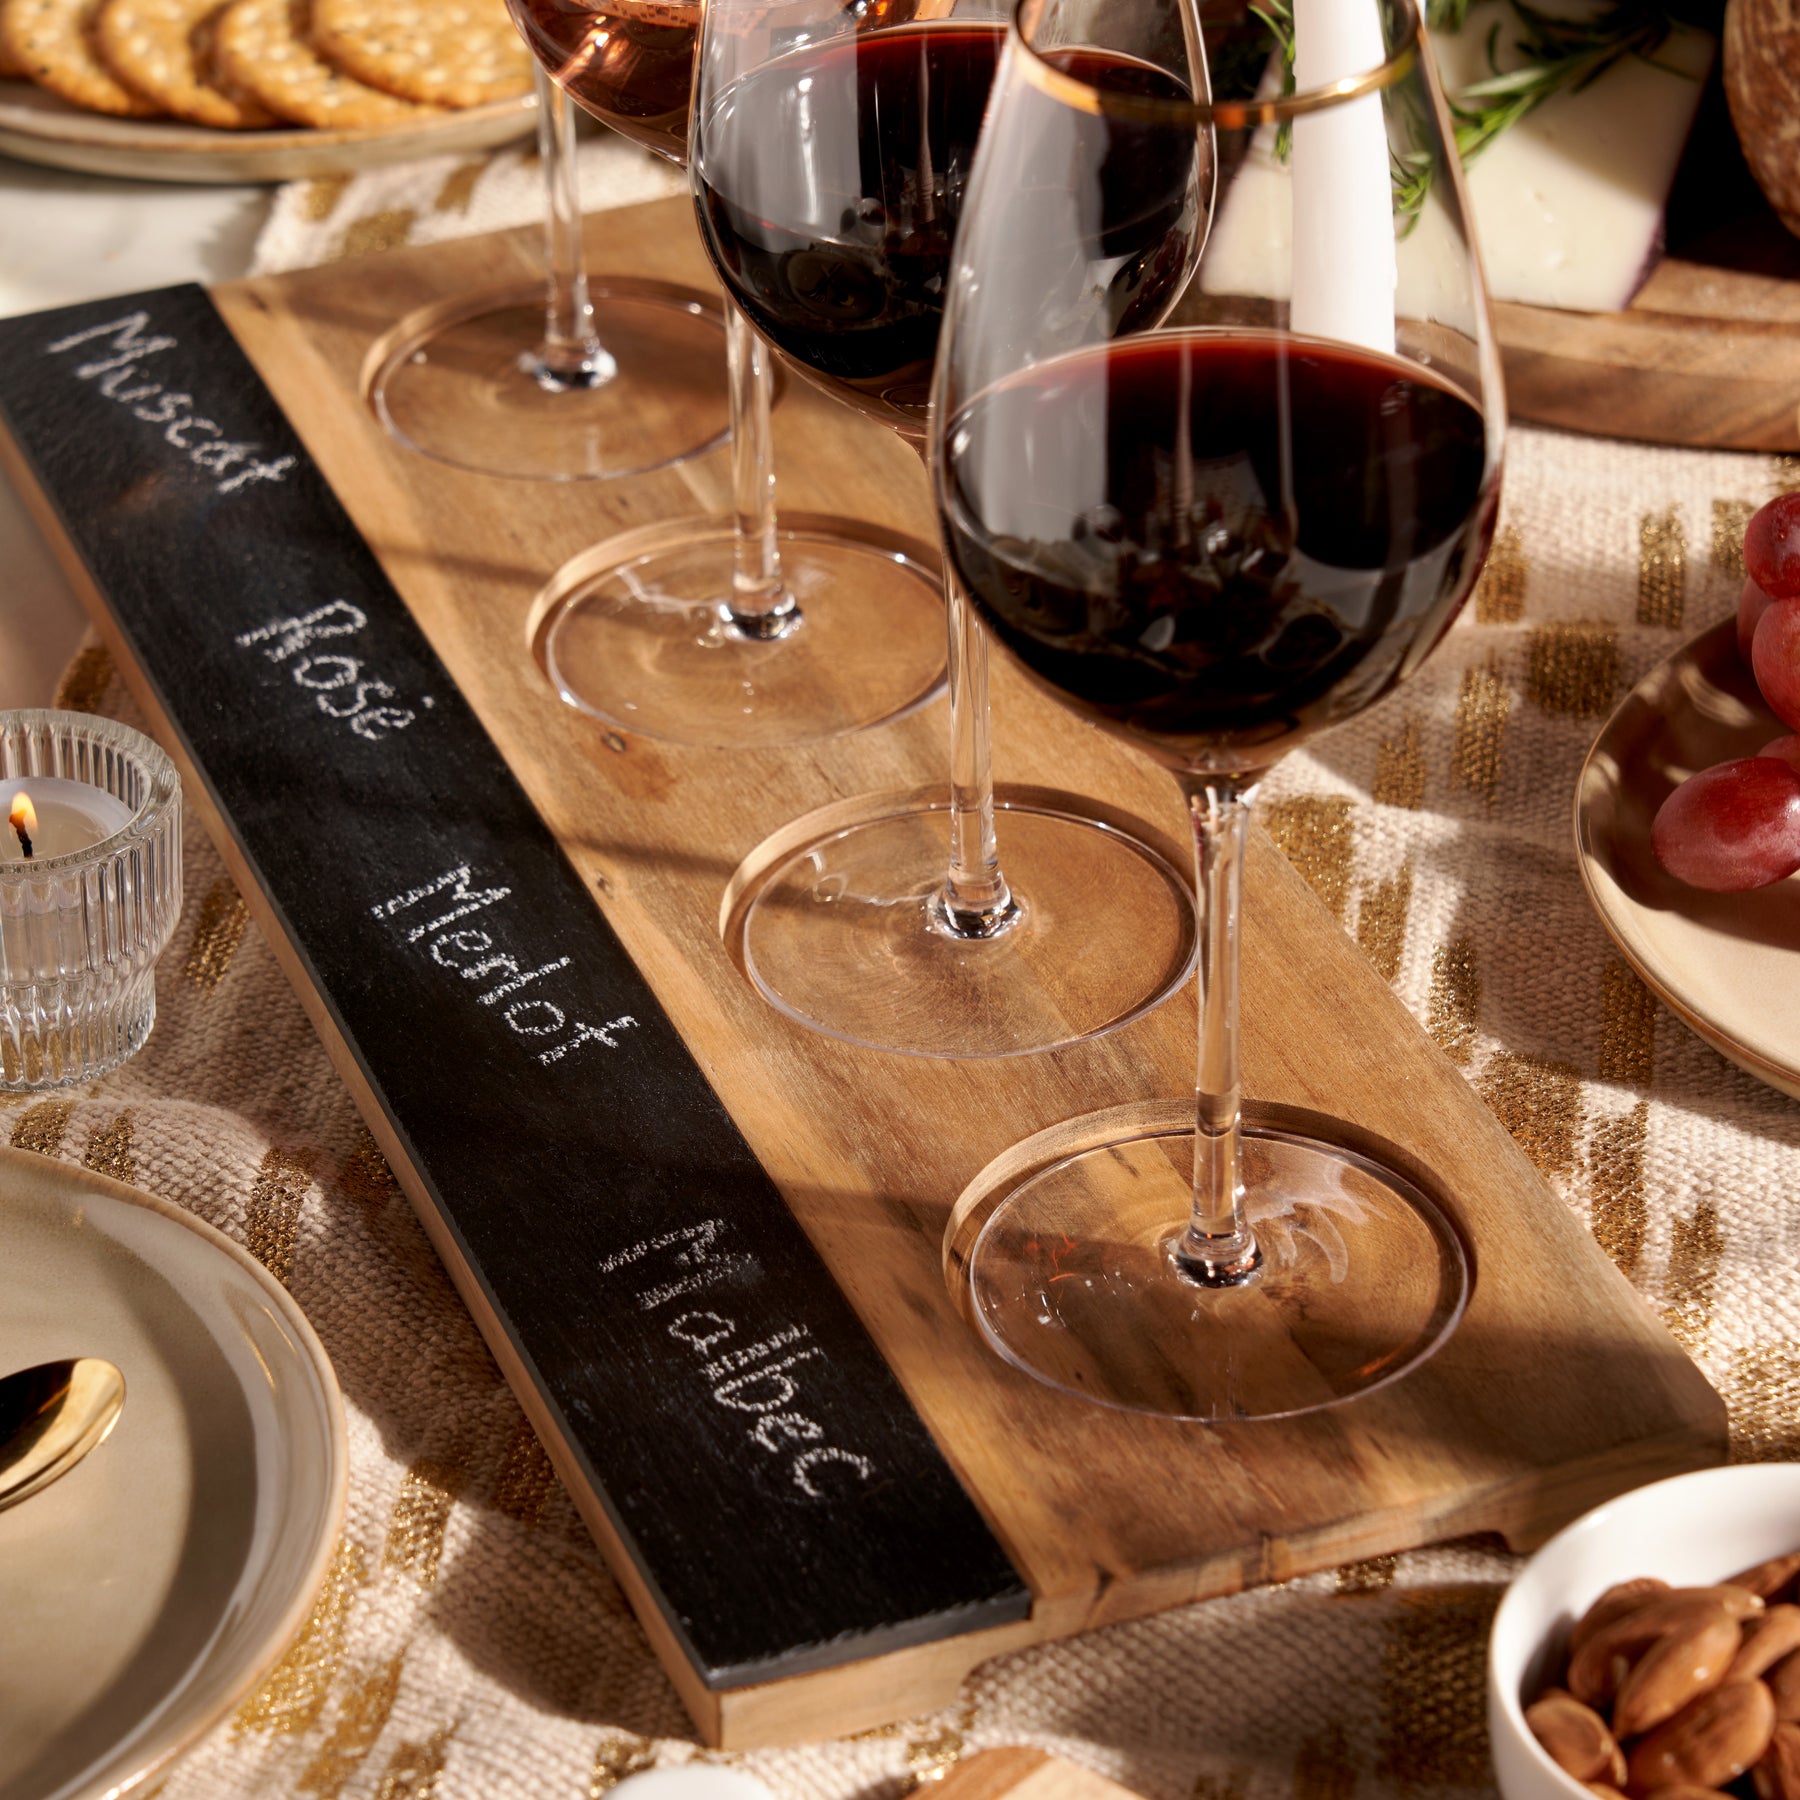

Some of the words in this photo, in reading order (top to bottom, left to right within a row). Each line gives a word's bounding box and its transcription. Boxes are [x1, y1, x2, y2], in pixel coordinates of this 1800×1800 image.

[47, 310, 298, 494] Muscat
[371, 860, 640, 1066] Merlot
[600, 1218, 874, 1498] Malbec
